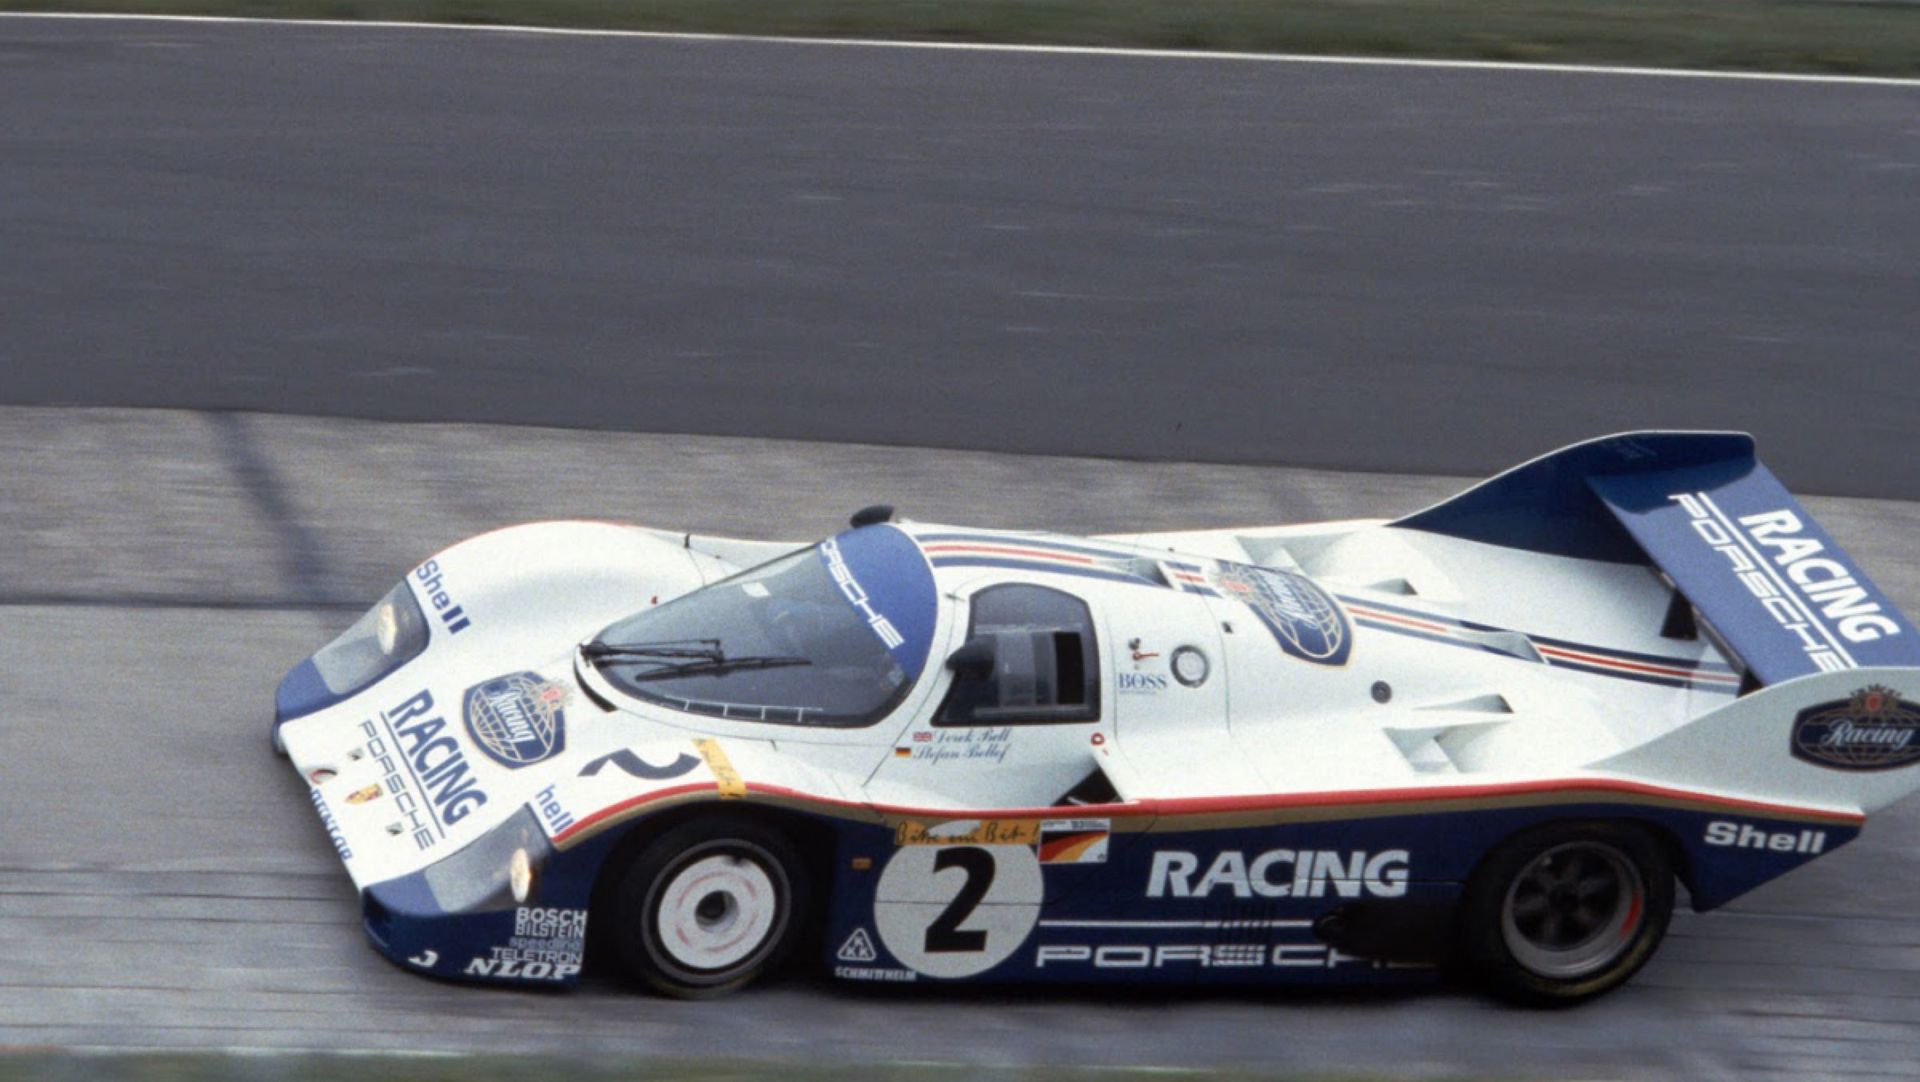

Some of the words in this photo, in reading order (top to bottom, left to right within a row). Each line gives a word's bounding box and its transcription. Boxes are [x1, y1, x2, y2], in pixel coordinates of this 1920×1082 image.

[416, 559, 471, 634] Shell
[820, 537, 904, 650] PORSCHE
[1668, 492, 1850, 673] PORSCHE
[1739, 510, 1900, 643] RACING
[1119, 674, 1168, 689] BOSS
[388, 689, 488, 826] RACING
[1821, 720, 1916, 750] Racing
[358, 719, 435, 851] PORSCHE
[1704, 820, 1826, 853] Shell
[924, 847, 996, 953] 2
[1146, 849, 1410, 898] RACING
[515, 922, 584, 938] BILSTEIN
[516, 907, 587, 926] BOSCH
[491, 947, 583, 964] TELETRON
